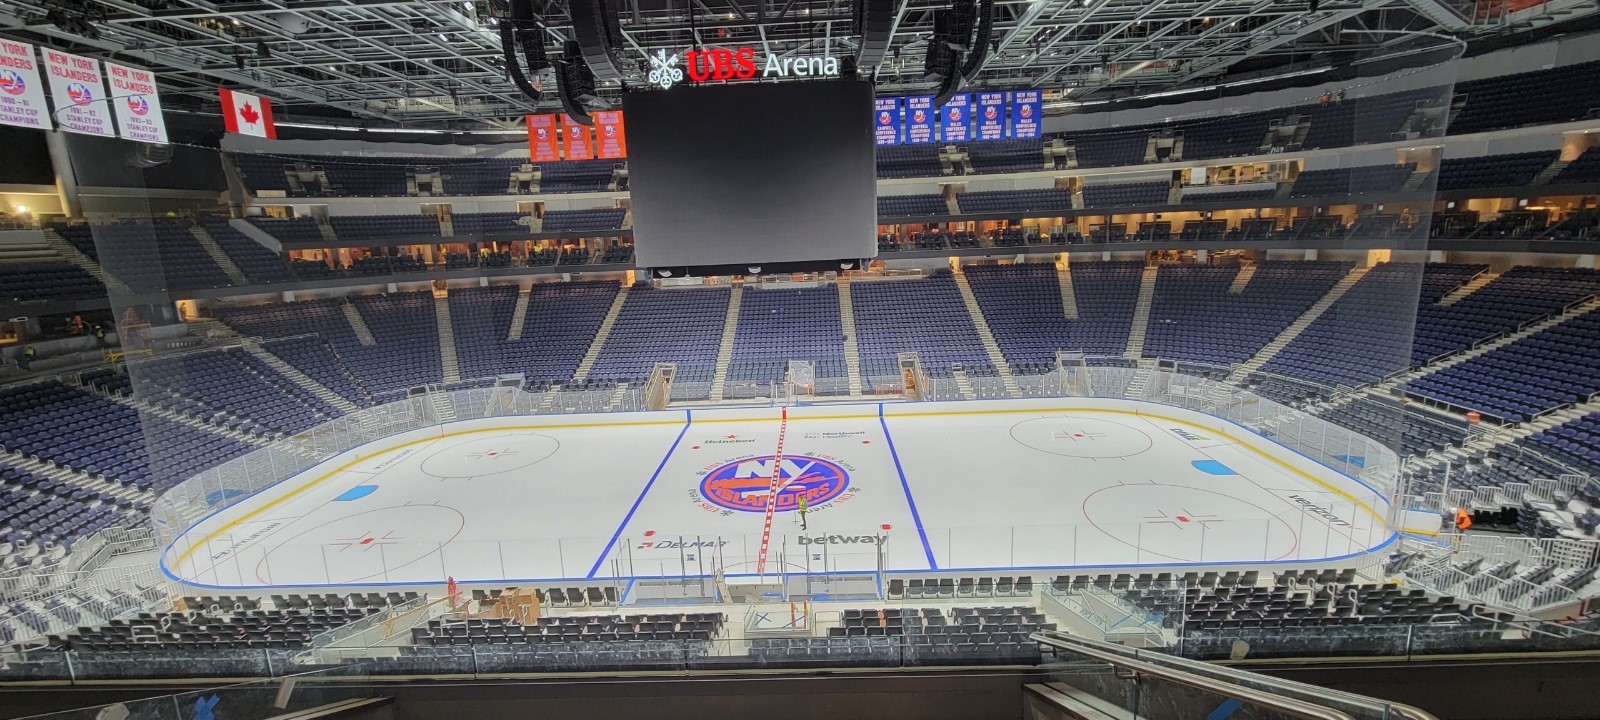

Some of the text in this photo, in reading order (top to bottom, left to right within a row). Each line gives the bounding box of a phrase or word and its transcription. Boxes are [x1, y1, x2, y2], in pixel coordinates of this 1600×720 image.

[1, 41, 28, 57] YORK
[48, 52, 94, 71] NEW YORK
[684, 47, 838, 81] UBS Arena
[51, 65, 98, 83] ISLANDERS
[111, 65, 150, 82] NEW YORK
[113, 78, 154, 94] ISLANDERS
[0, 114, 40, 125] CHAMPIONS
[25, 108, 38, 117] CUP
[66, 114, 103, 126] STANLEY CUP
[70, 123, 104, 134] CHAMPIONS
[127, 123, 148, 132] STANLEY
[130, 131, 159, 141] CHAMPIONS
[1288, 494, 1350, 526] verizon
[798, 535, 888, 546] betway
